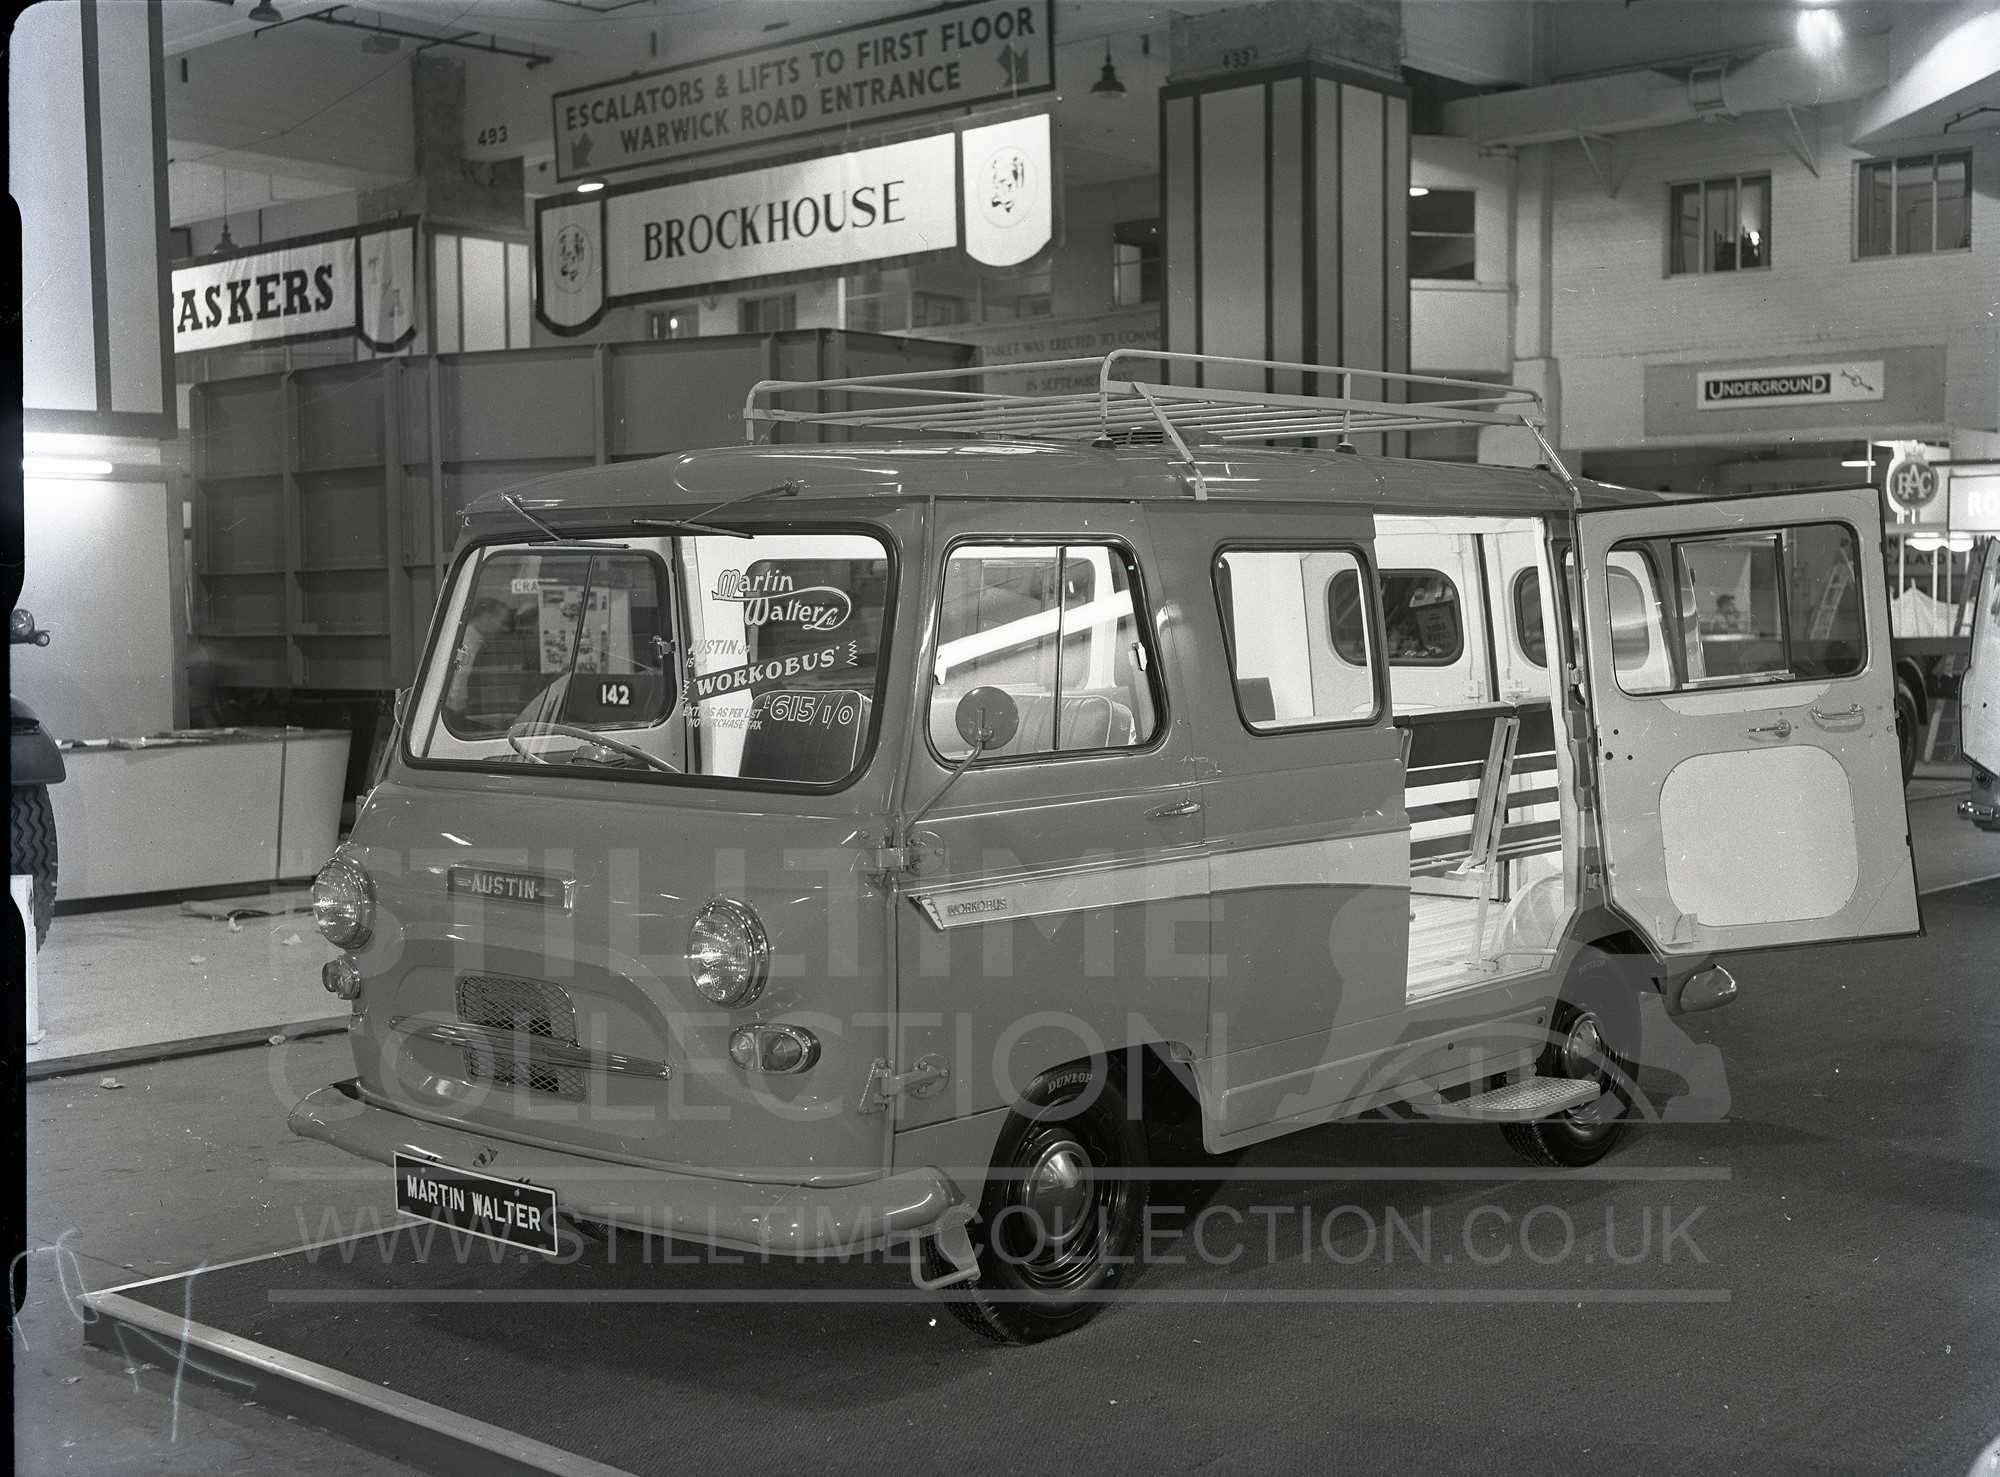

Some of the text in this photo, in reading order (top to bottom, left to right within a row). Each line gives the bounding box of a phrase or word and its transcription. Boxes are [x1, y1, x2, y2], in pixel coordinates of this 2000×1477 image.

[565, 6, 1036, 131] ESCALATORS & LIFTS TO FIRST FLOOR
[620, 61, 961, 154] WARWICK ROAD ENTRANCE
[477, 125, 508, 146] 493
[643, 179, 907, 263] BROCKHOUSE
[172, 263, 334, 333] ASKERS
[1709, 375, 1827, 399] UNDERGROUND
[1896, 463, 1932, 500] RAC
[717, 568, 794, 598] Martin
[744, 597, 824, 626] Walter
[601, 684, 631, 706] 142
[702, 718, 745, 730] RCHASE
[745, 708, 763, 719] LST
[471, 872, 536, 899] AUSTIN
[1047, 1072, 1094, 1095] DUNLOP
[406, 1174, 542, 1232] MARTIN WALTER
